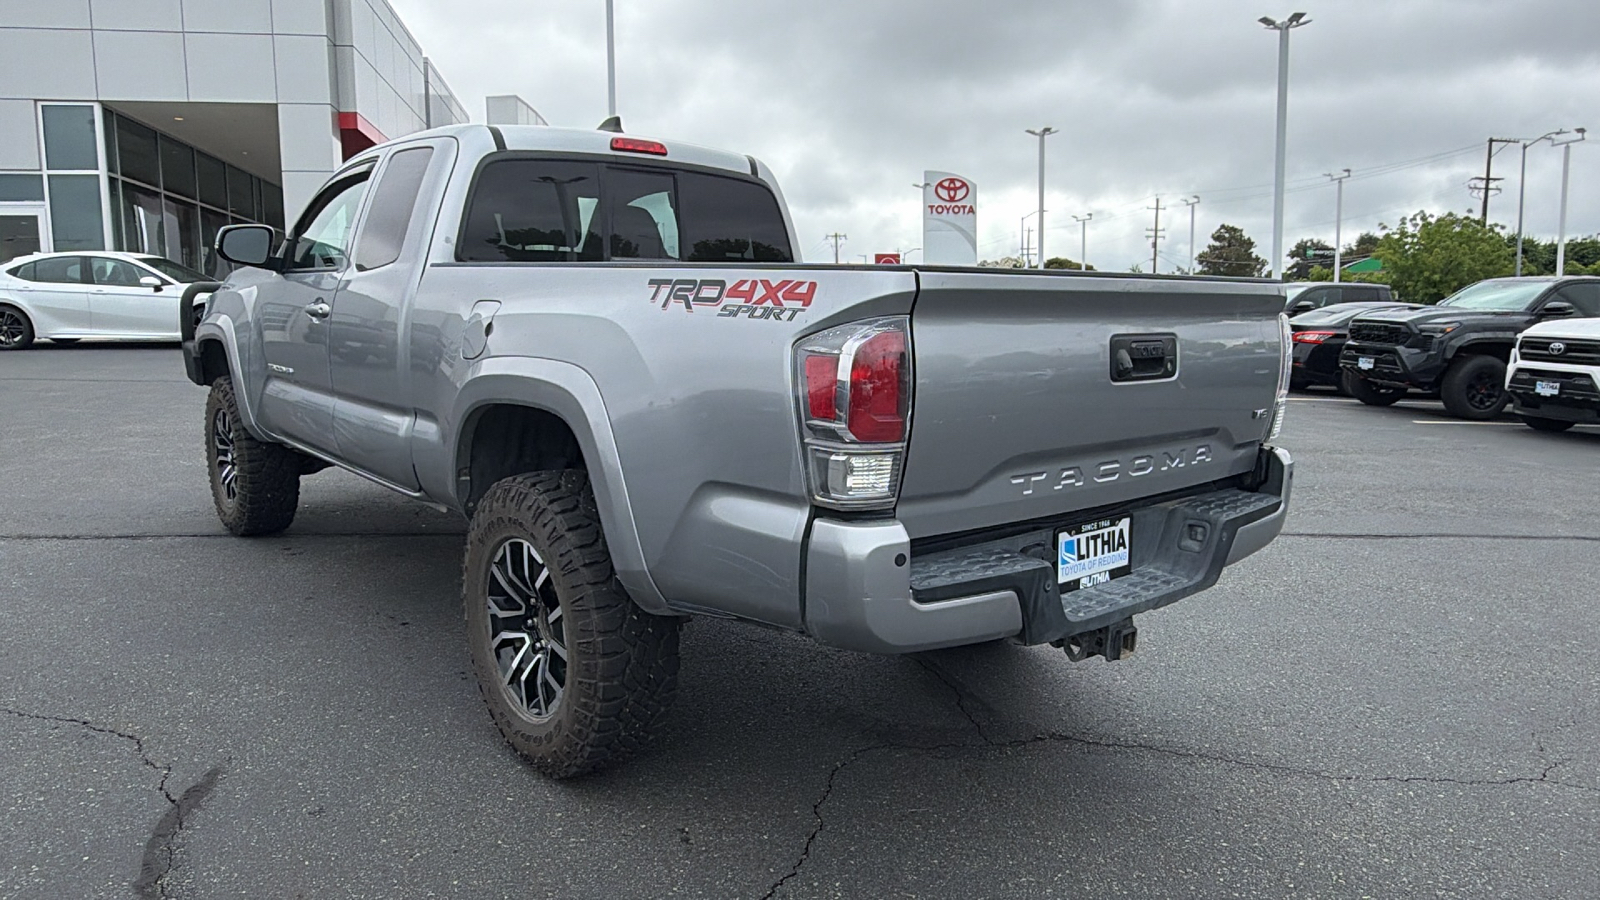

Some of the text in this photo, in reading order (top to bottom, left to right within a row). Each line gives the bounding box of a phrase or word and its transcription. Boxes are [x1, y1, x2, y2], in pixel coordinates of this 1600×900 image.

[928, 205, 975, 215] TOYOTA
[648, 279, 818, 313] TRD 4X4
[717, 304, 807, 322] SPORT
[1010, 444, 1212, 495] TACOMA
[1081, 522, 1097, 532] SINCE
[1076, 528, 1127, 561] LITHIA
[1061, 552, 1127, 577] TOYOTA OF REDDING
[1087, 571, 1110, 587] LITHIA
